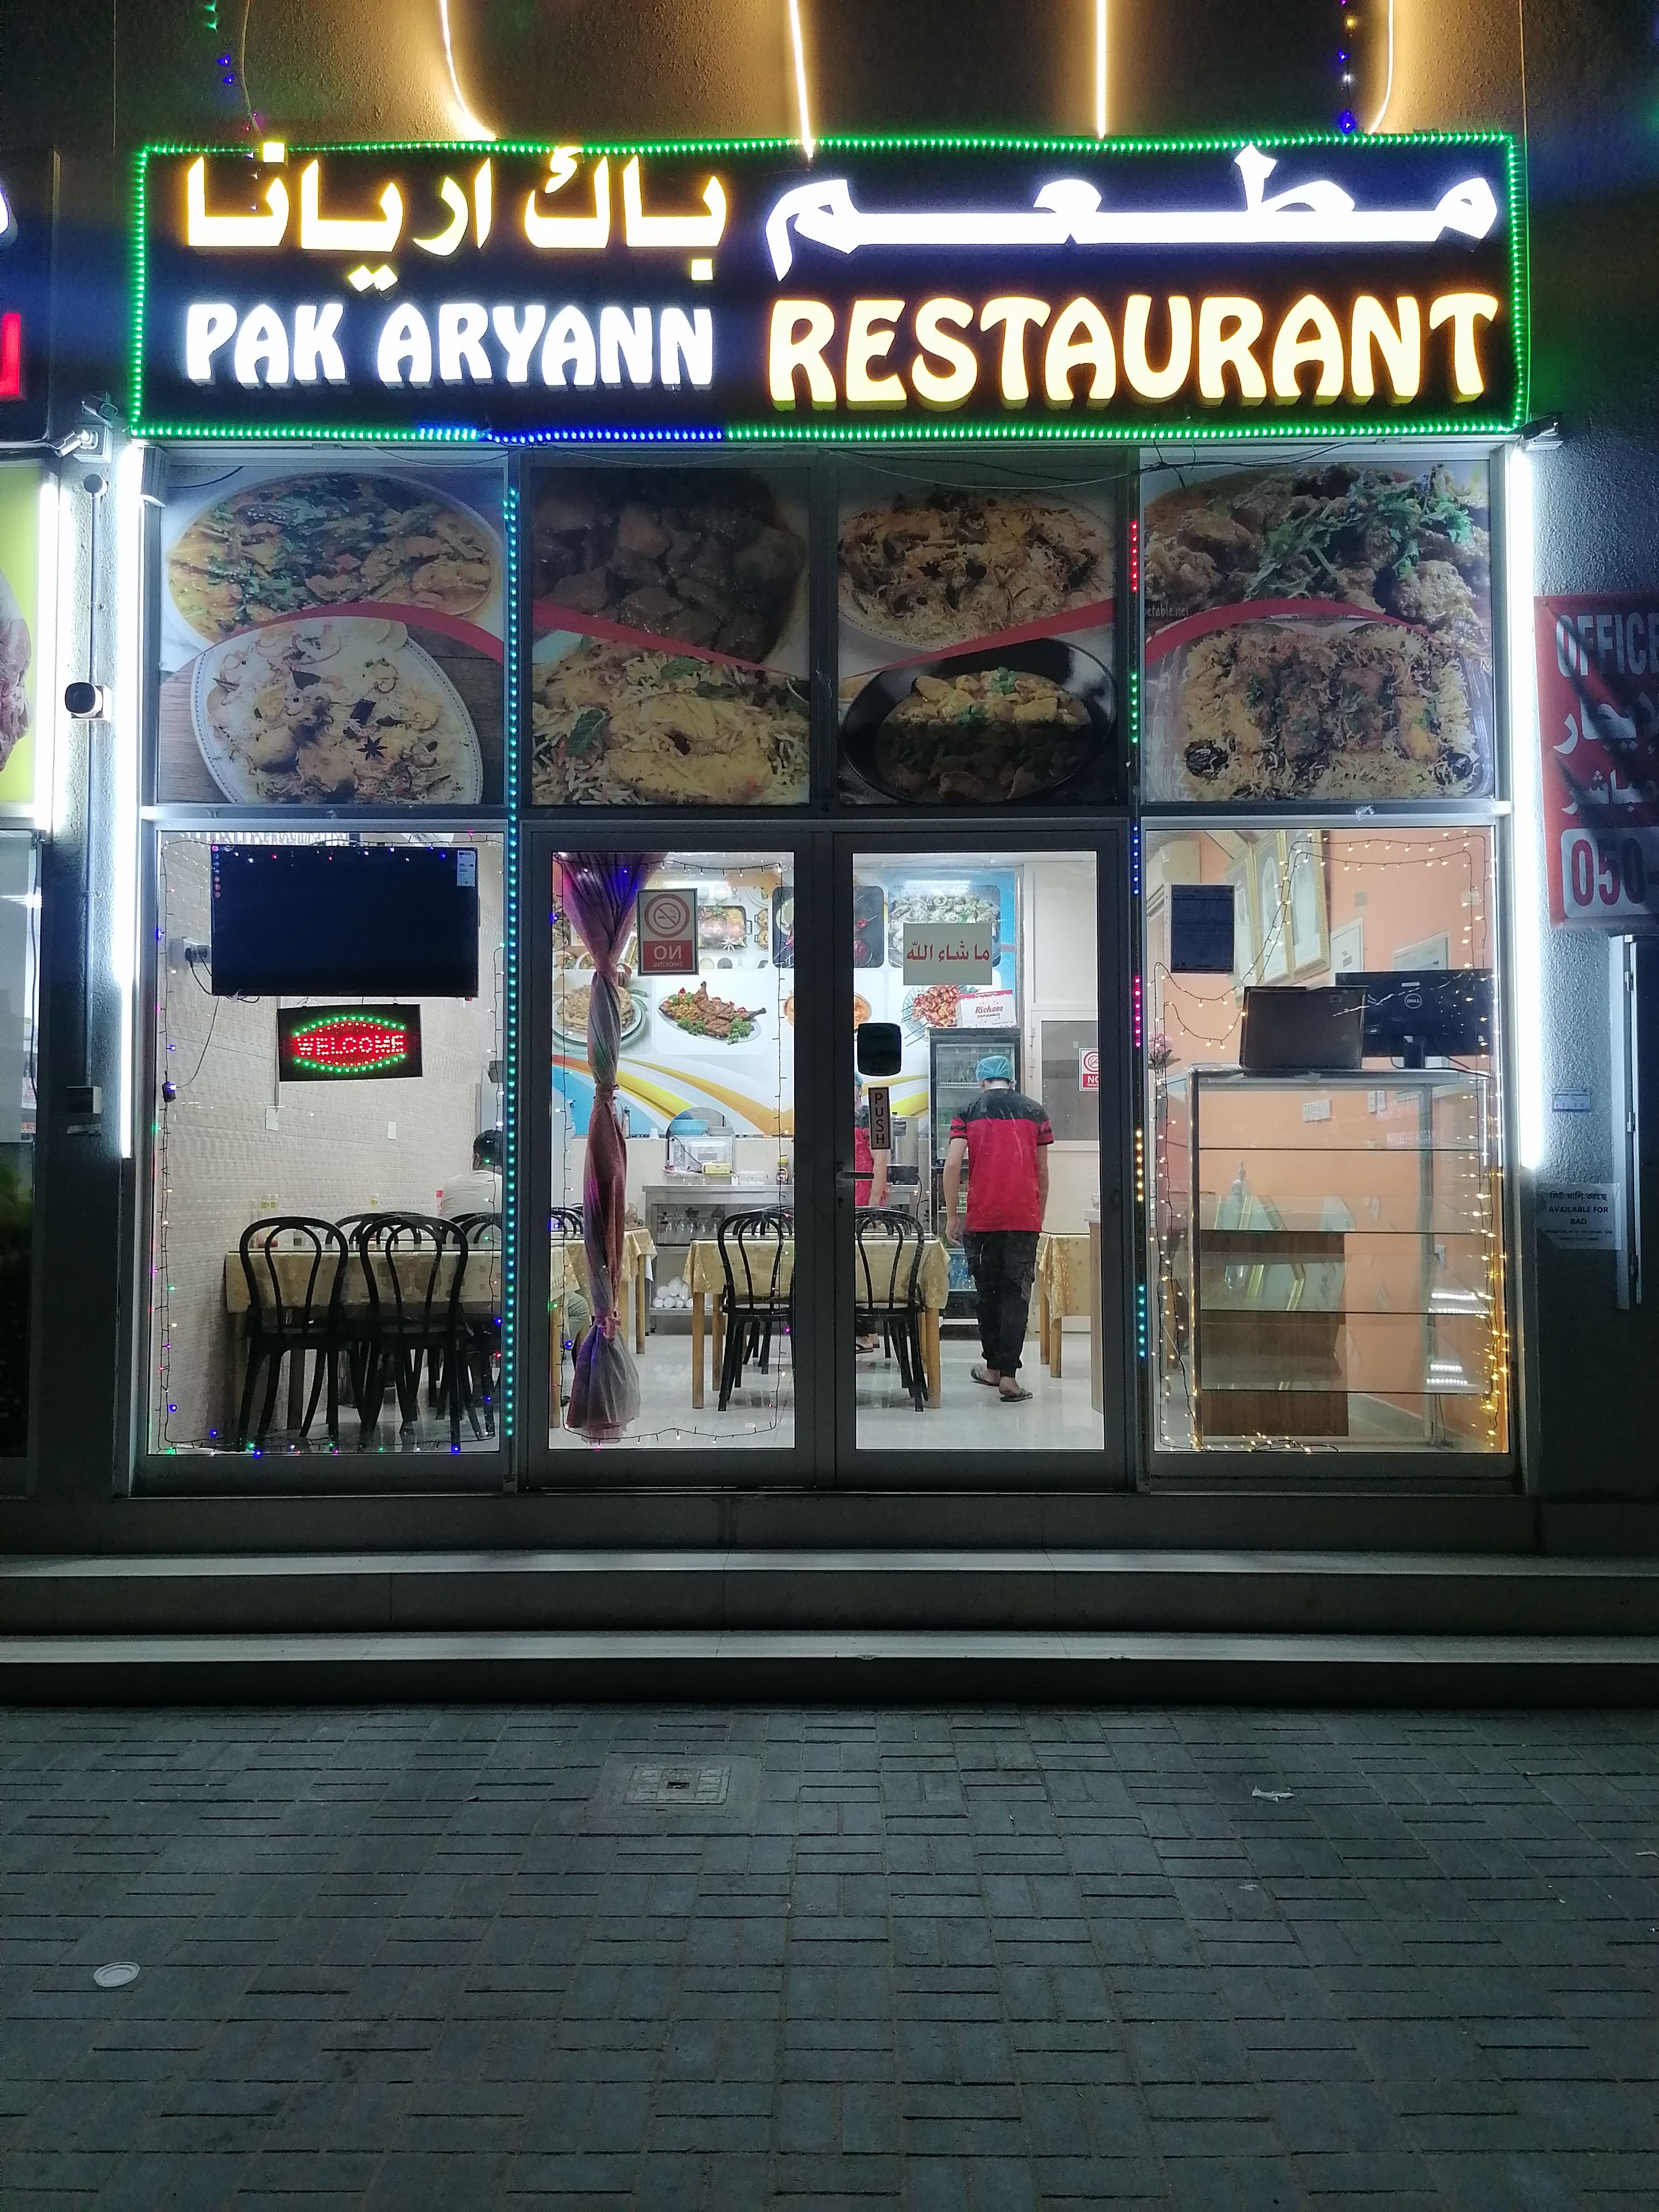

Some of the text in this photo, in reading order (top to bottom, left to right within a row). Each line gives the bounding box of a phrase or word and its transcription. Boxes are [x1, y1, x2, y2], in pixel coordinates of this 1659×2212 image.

[522, 143, 728, 281] باك
[765, 143, 1499, 281] مطعم
[183, 293, 1499, 408] PAK ARYANN RESTAURANT
[296, 1035, 404, 1055] WELCOME
[875, 1092, 885, 1145] PUSH
